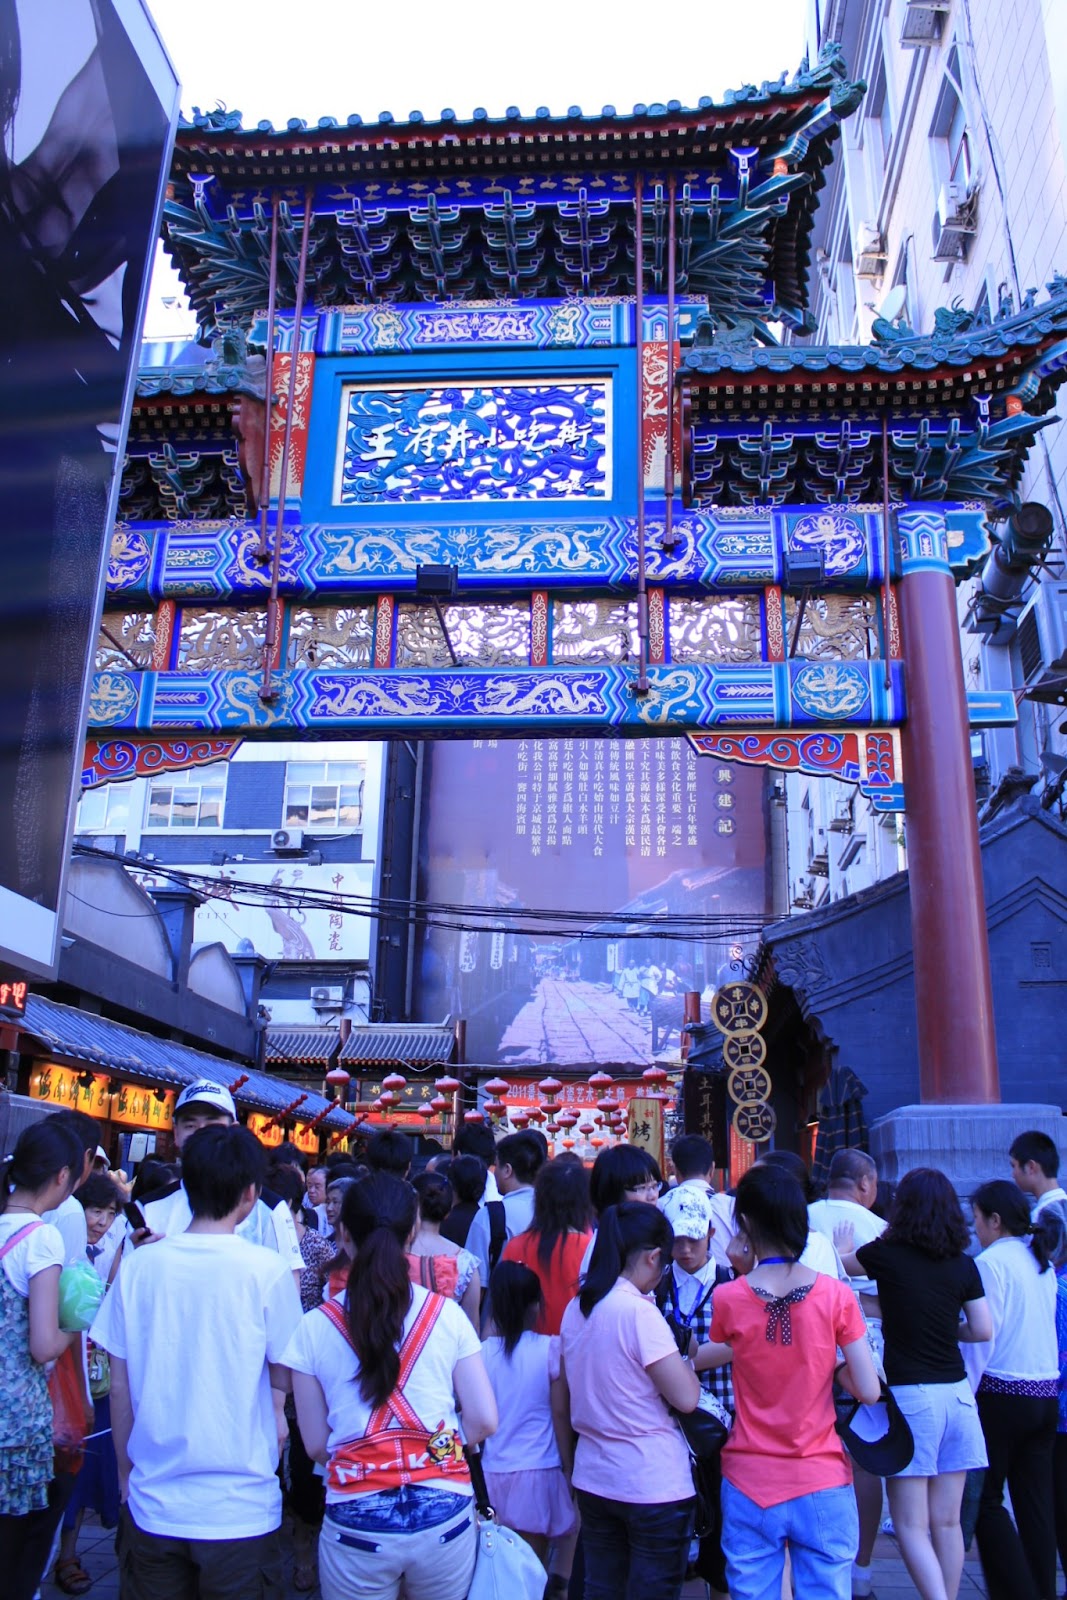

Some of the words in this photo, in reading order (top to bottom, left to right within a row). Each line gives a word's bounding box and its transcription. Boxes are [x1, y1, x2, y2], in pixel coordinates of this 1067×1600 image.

[361, 419, 592, 461] 王府井小吃街
